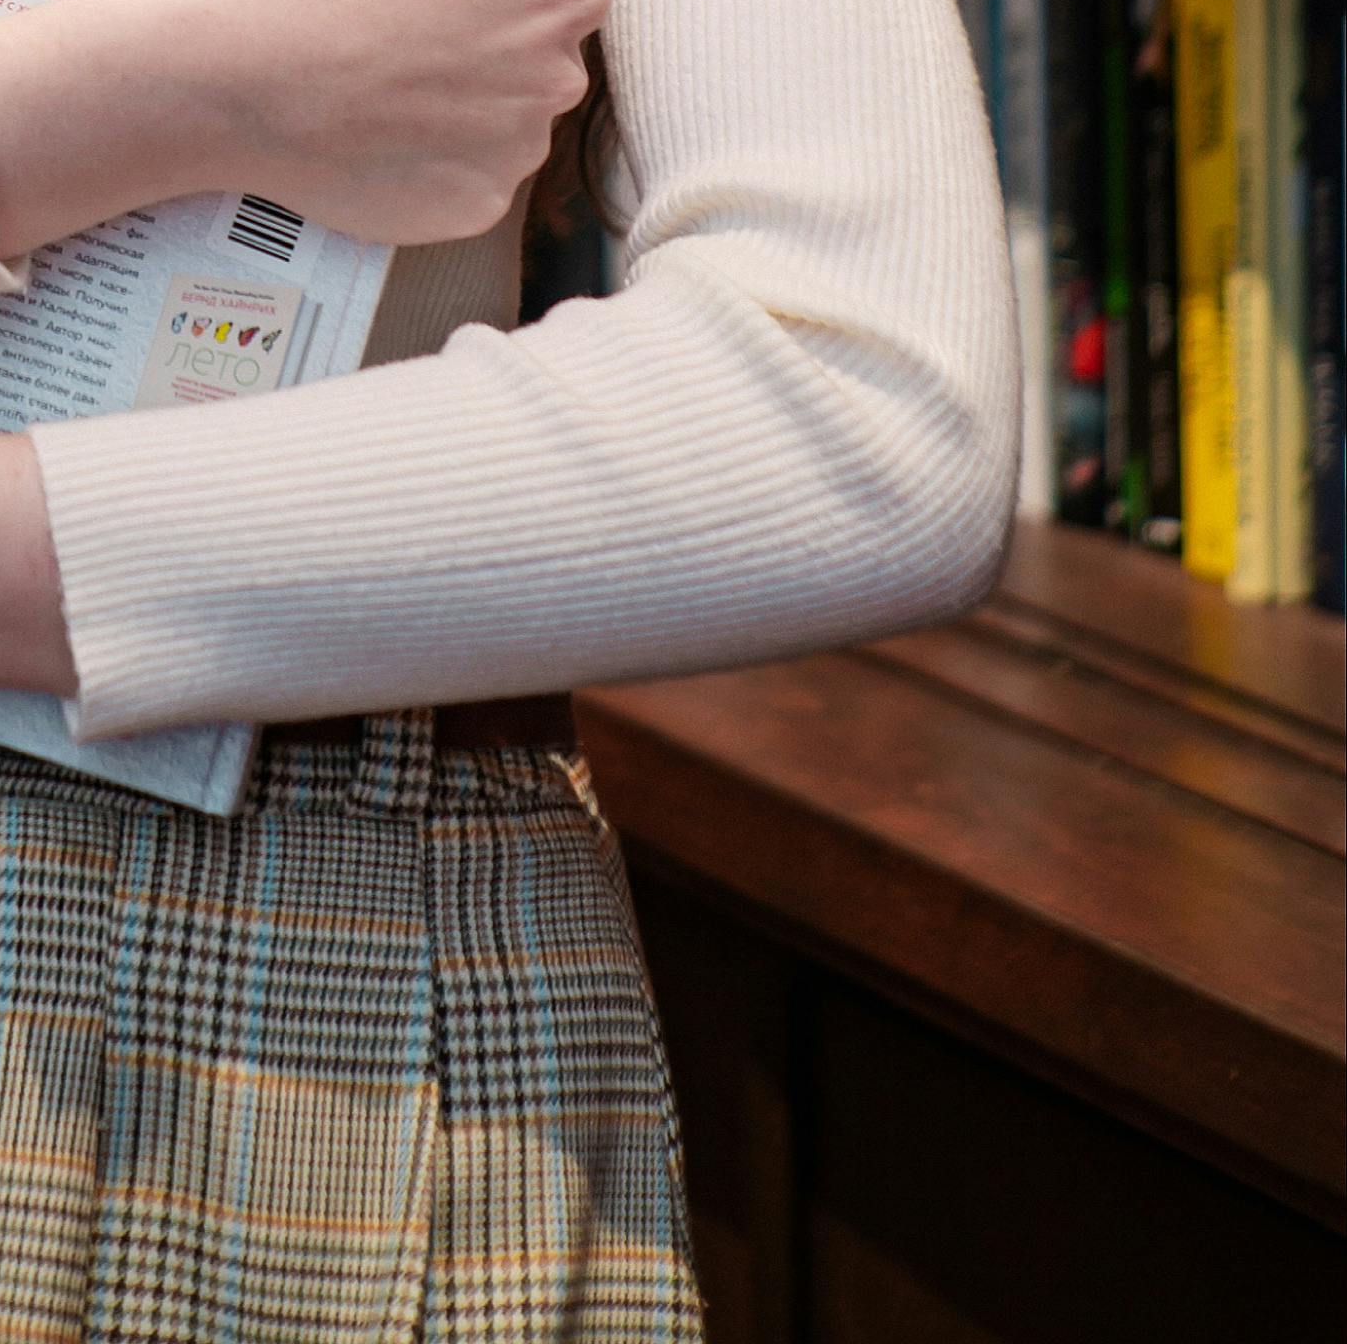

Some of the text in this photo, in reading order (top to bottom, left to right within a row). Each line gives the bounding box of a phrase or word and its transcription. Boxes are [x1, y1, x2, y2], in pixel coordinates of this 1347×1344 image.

[7, 2, 15, 10] с
[75, 253, 139, 278] адаптация
[58, 266, 93, 284] числе
[100, 280, 133, 295] насе-
[76, 290, 128, 315] Получил
[40, 300, 122, 331] Калифорний-
[45, 321, 83, 342] Автор
[35, 378, 70, 397] более
[66, 368, 106, 387] Новый
